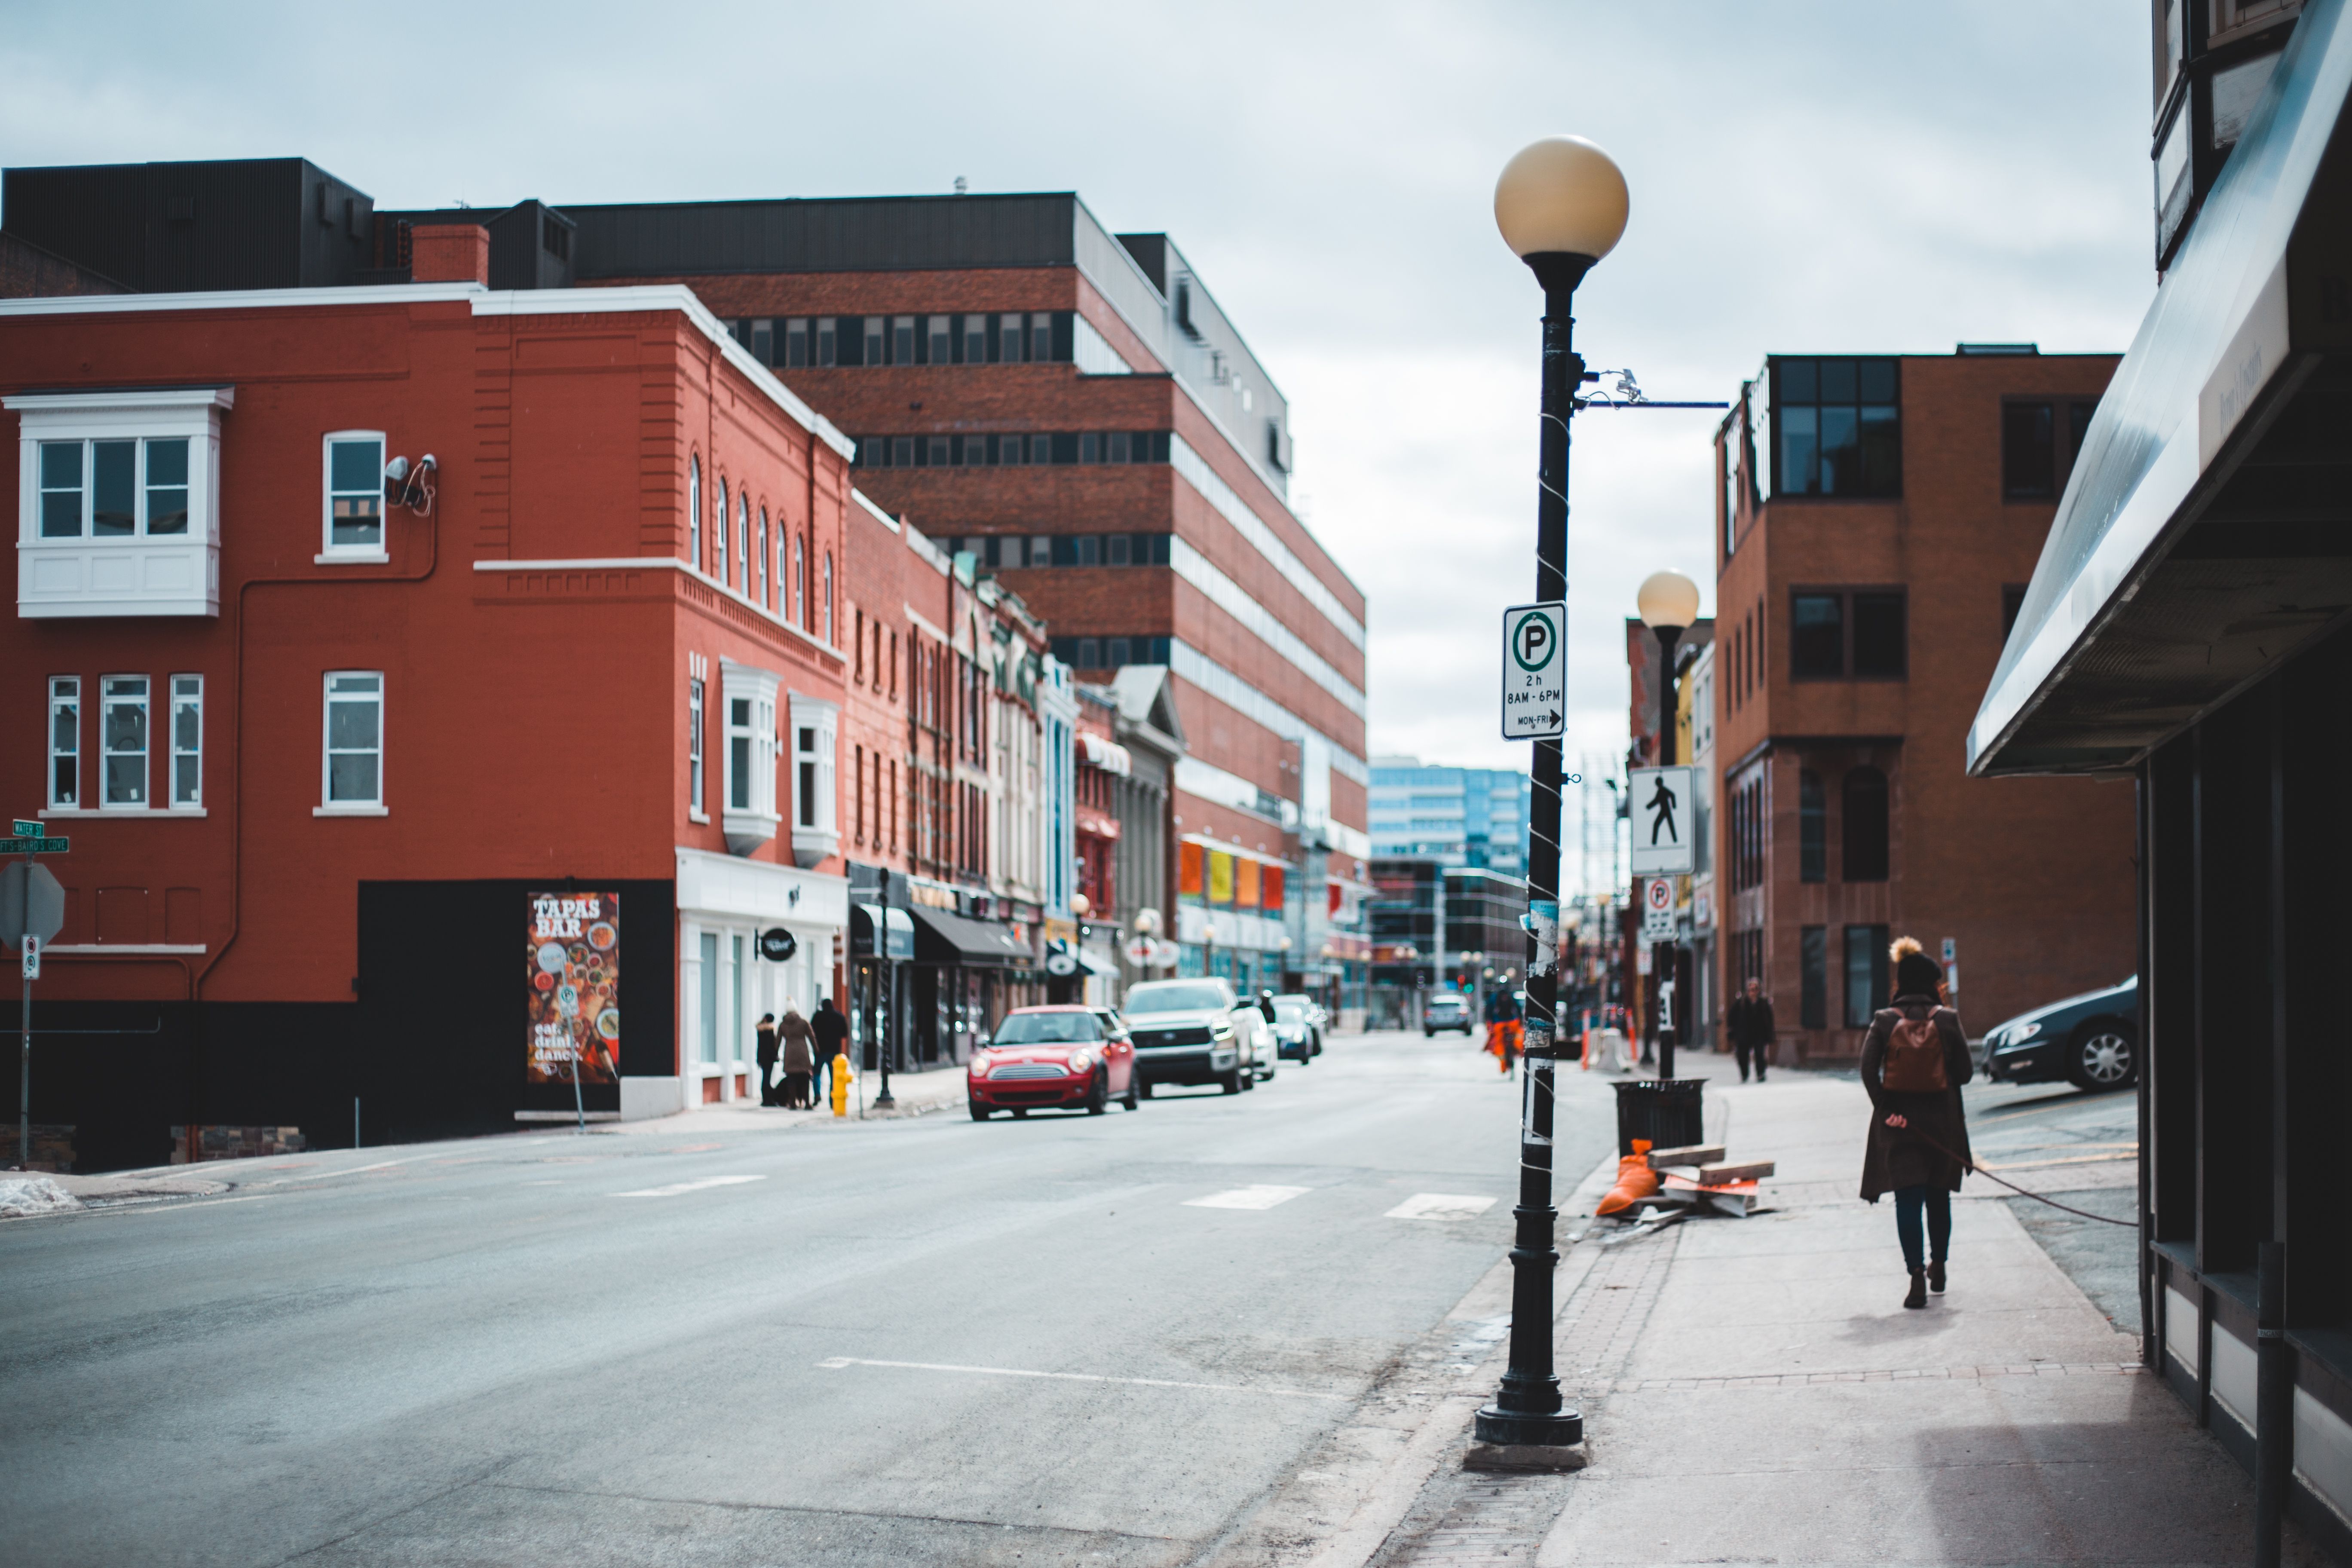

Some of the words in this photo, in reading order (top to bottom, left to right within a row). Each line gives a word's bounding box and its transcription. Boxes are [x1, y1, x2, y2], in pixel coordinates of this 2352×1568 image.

[2239, 339, 2262, 413] Upstairs
[1525, 625, 1547, 660] P
[1526, 675, 1532, 686] 2
[1536, 675, 1541, 686] h
[1508, 692, 1529, 704] 8AM
[1539, 689, 1560, 702] 6PM
[1518, 715, 1548, 725] MON-FRI
[15, 823, 33, 835] WATER
[35, 825, 42, 837] ST
[48, 839, 66, 851] COVE
[533, 899, 600, 919] TAPAS
[536, 919, 583, 938] BAR
